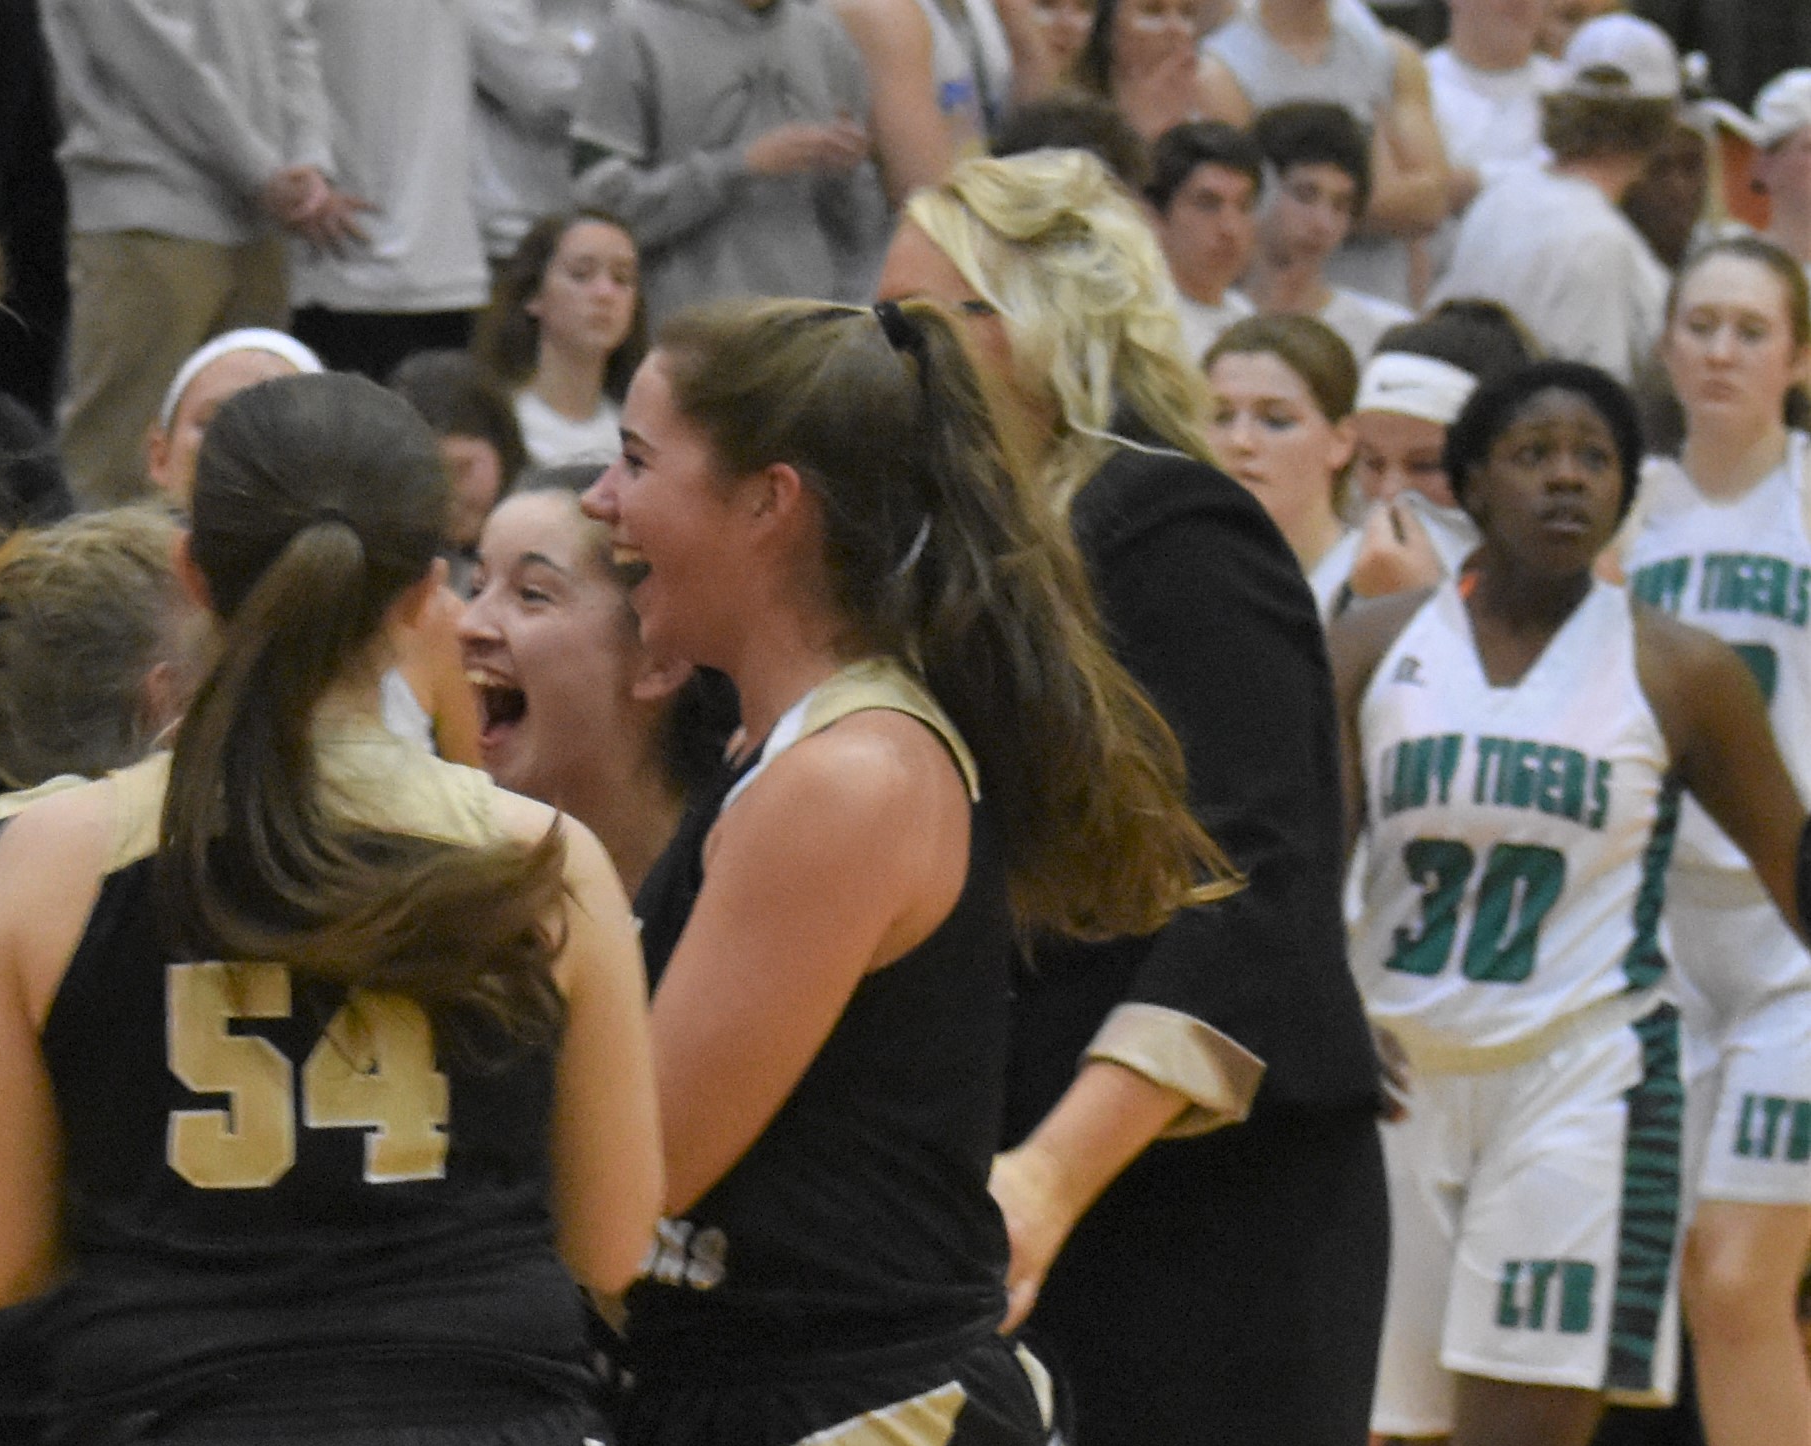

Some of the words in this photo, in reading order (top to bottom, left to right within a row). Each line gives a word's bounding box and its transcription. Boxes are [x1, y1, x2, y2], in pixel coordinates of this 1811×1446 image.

[1473, 735, 1613, 831] TIGERS
[1382, 838, 1567, 983] 30
[165, 959, 451, 1189] 54
